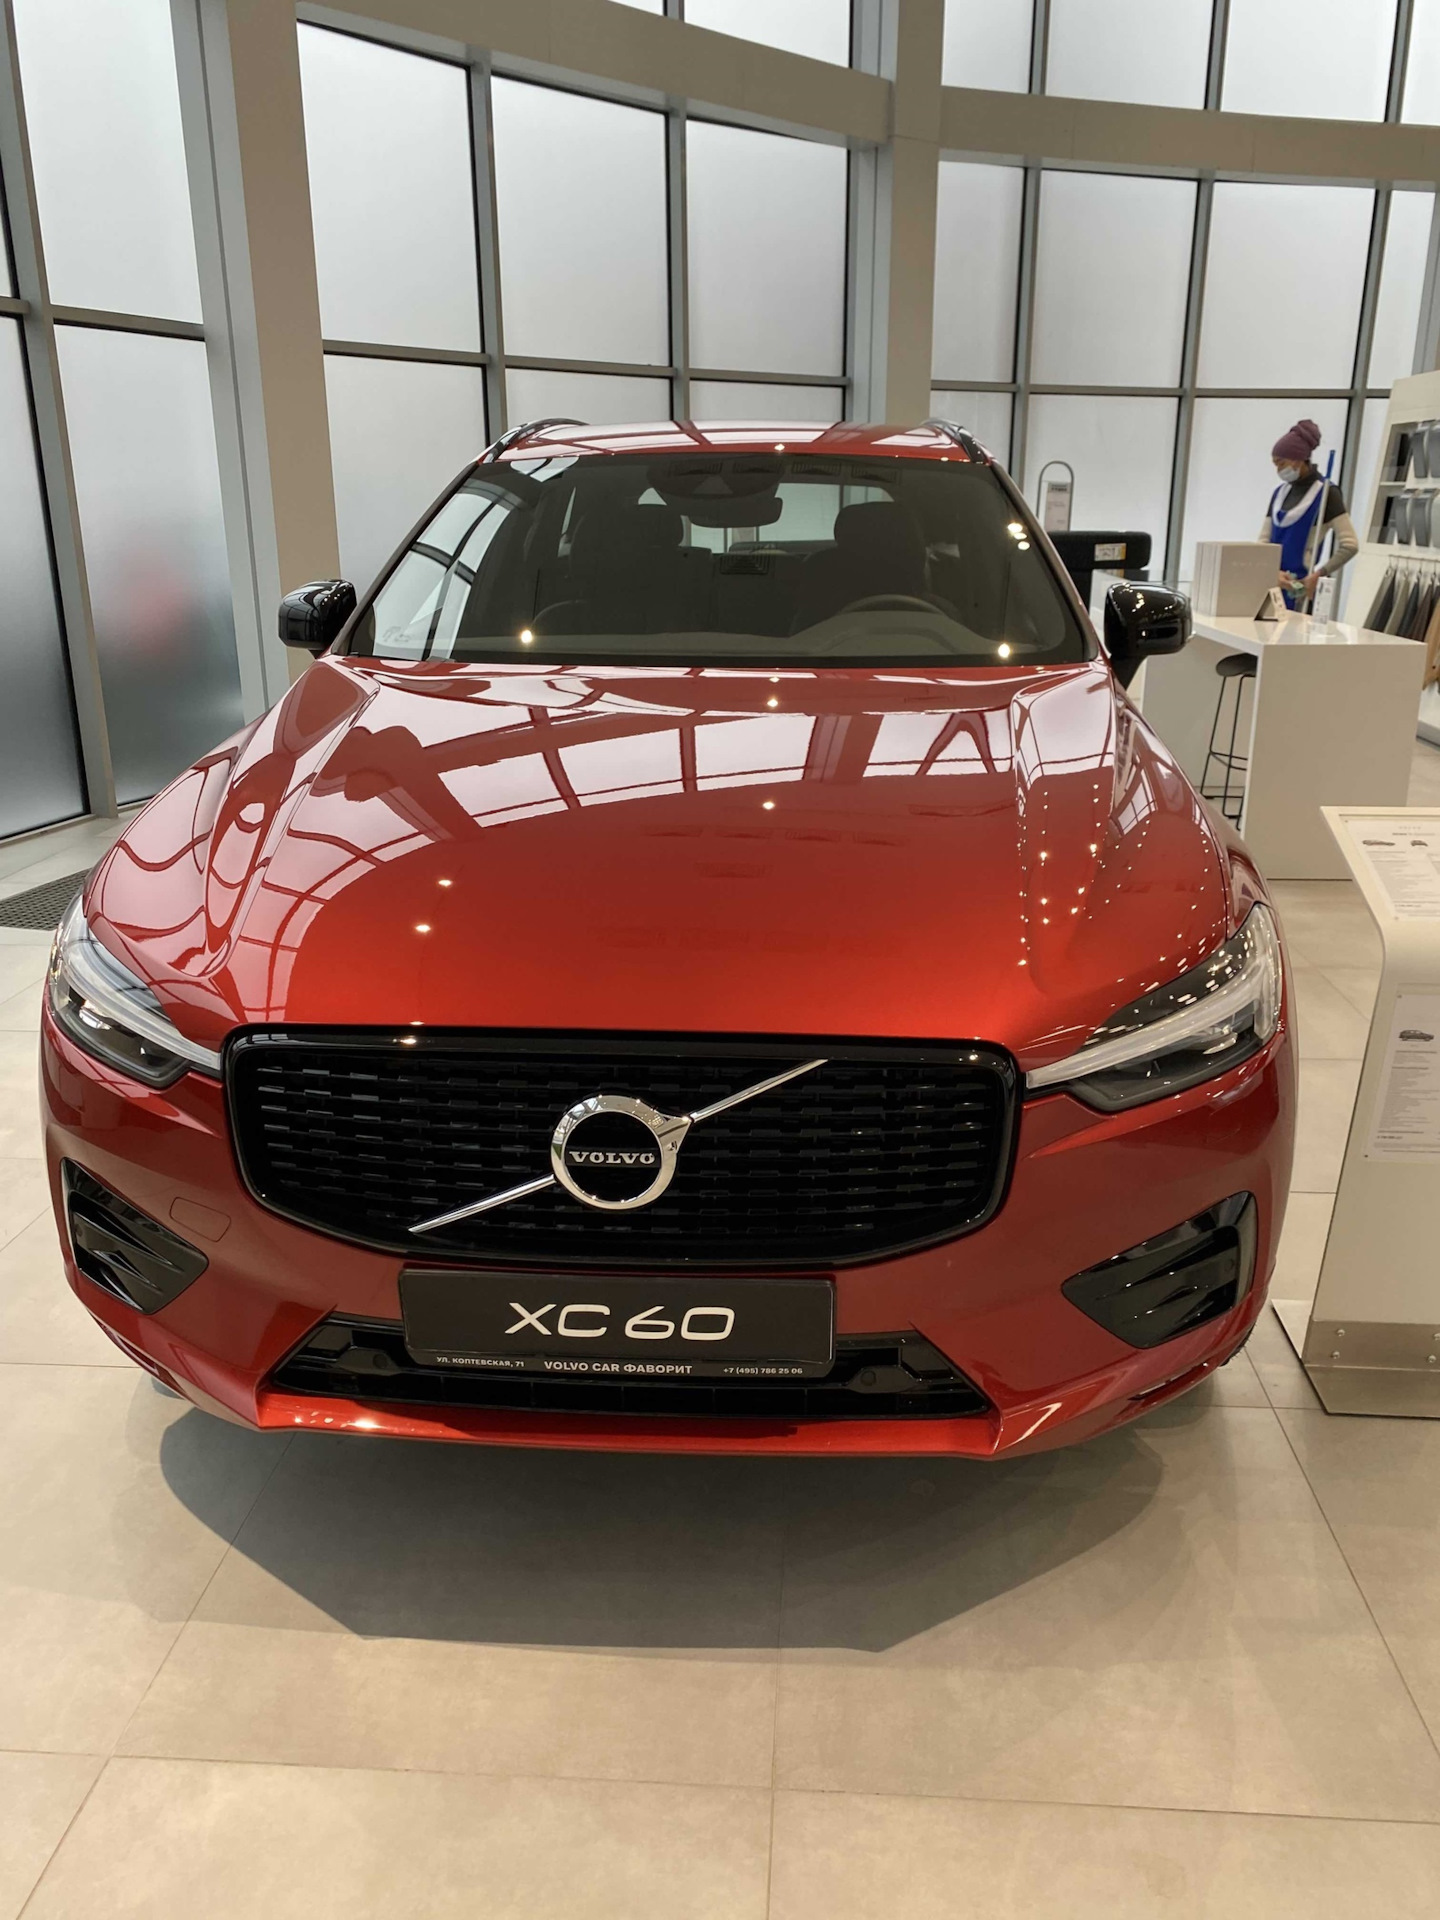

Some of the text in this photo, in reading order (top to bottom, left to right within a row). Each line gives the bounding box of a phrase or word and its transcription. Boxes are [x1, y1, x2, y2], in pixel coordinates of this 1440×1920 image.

[568, 1151, 655, 1165] VOLVO
[504, 1302, 736, 1341] XC 60
[436, 1356, 451, 1364] УЛ.
[452, 1357, 514, 1368] КОПТЕВСКАЯ,
[543, 1361, 693, 1374] VOLVO CAR ФАВОРИТ
[736, 1366, 759, 1375] (495)
